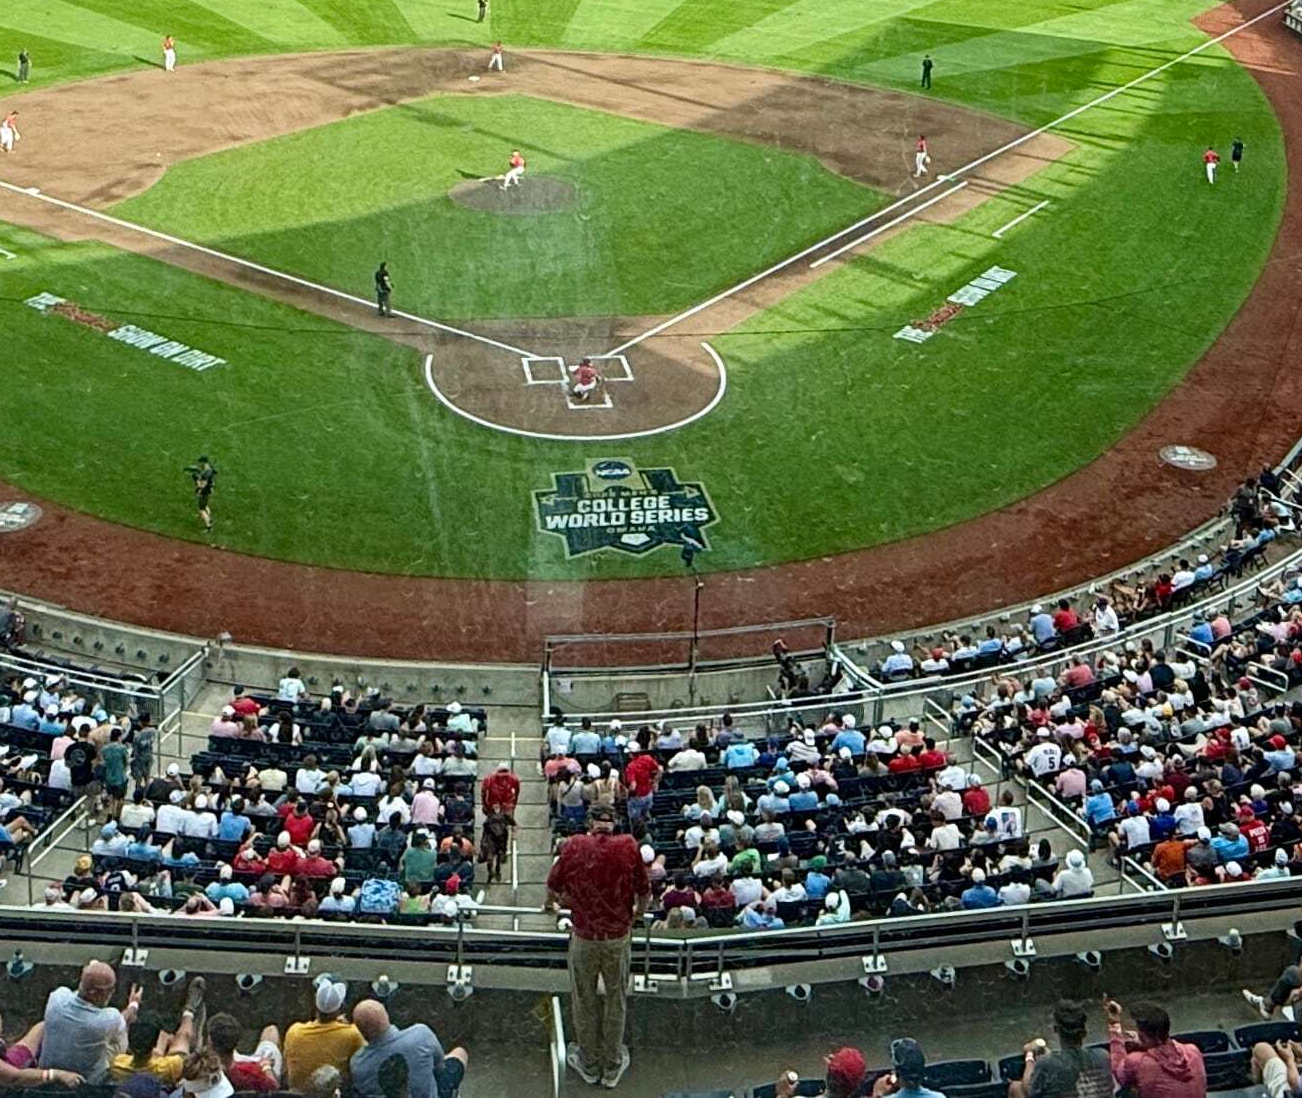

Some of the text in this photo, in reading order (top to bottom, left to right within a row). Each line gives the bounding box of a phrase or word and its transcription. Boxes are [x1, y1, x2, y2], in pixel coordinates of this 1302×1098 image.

[595, 467, 631, 476] NCAA
[576, 496, 671, 514] COLLEGE
[545, 508, 709, 529] WORLD SERIES
[606, 525, 657, 534] OMAHA
